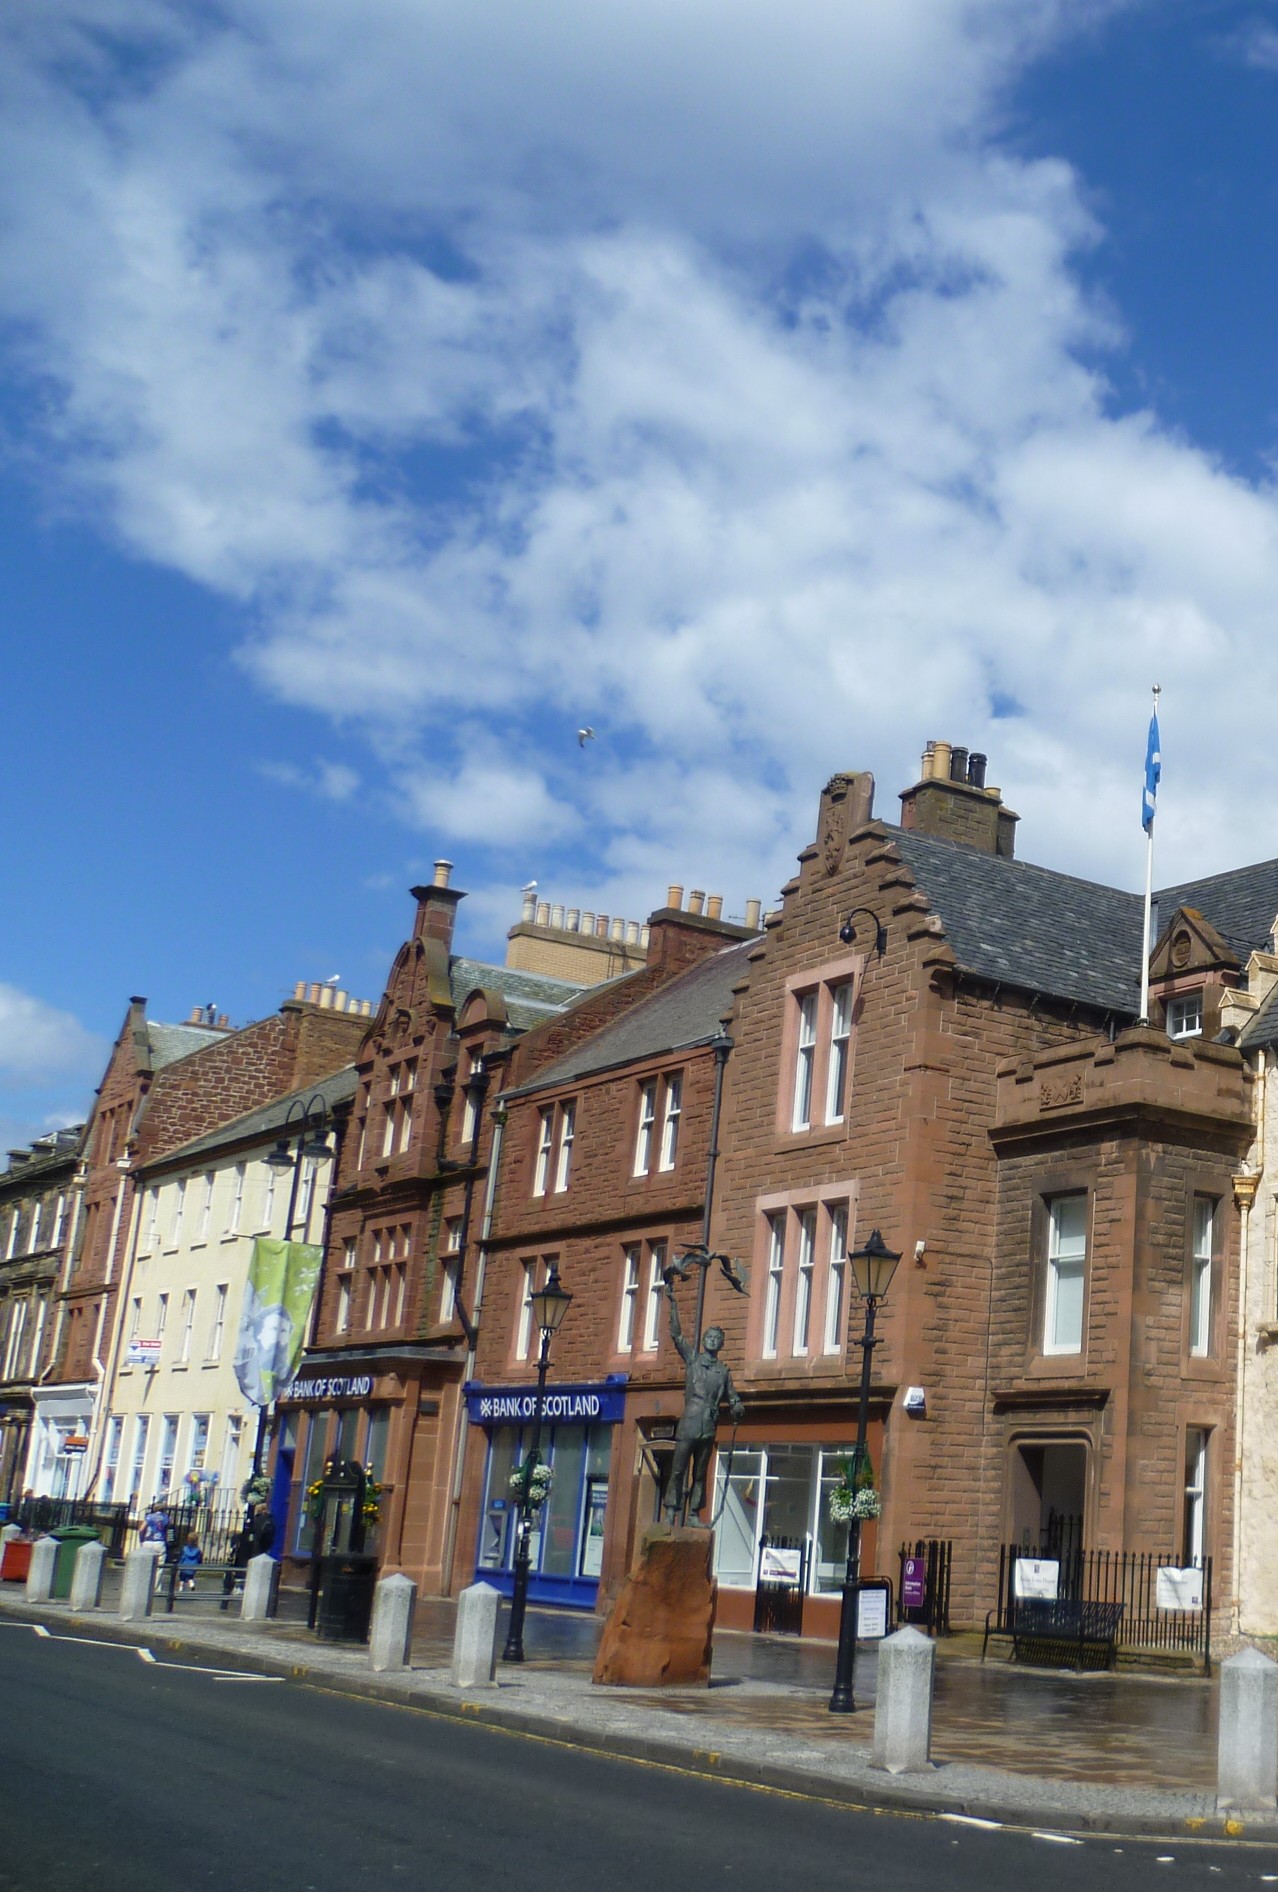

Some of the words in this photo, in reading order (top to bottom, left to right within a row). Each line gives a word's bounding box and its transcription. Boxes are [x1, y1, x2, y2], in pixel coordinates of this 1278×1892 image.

[293, 1381, 314, 1397] BANK
[315, 1379, 327, 1396] OF
[327, 1376, 370, 1396] SCOTLAND
[493, 1397, 521, 1417] BANK
[523, 1397, 538, 1416] OF
[541, 1395, 600, 1416] SCOTLAND
